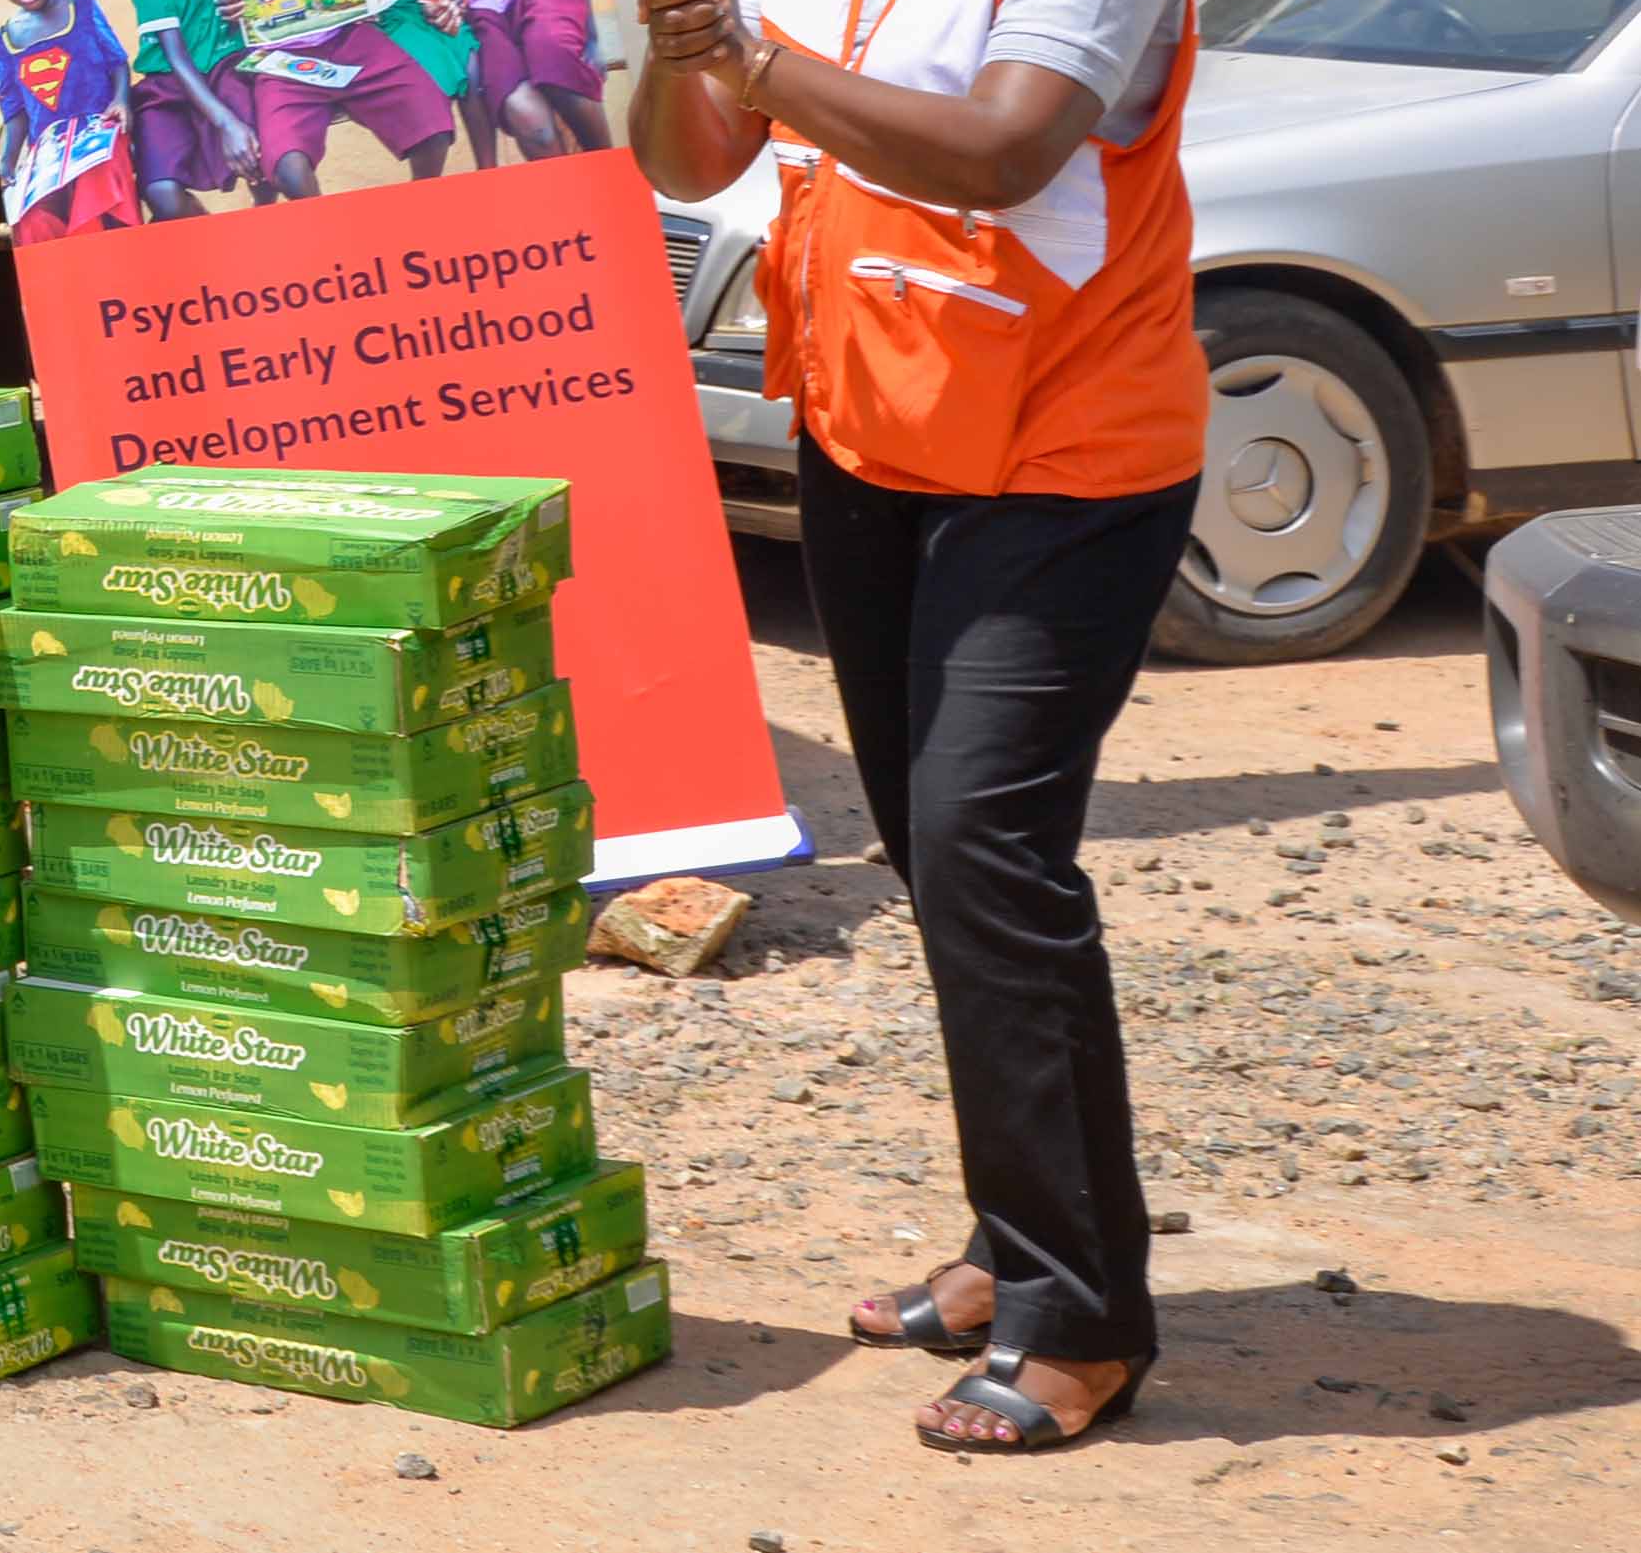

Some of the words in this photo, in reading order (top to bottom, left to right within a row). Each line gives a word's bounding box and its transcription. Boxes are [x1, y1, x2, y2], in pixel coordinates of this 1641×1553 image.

[99, 258, 388, 343] Psychosocial
[402, 231, 596, 293] Support
[125, 355, 207, 403] and
[221, 339, 336, 386] Early
[354, 294, 595, 365] Childhood
[111, 397, 425, 473] Development
[438, 367, 635, 422] Services
[103, 566, 179, 604] Star
[183, 570, 292, 612] White
[73, 666, 143, 705] Star
[147, 668, 251, 714] White
[130, 730, 231, 776] White
[233, 740, 308, 781] Star
[146, 822, 246, 866] White
[248, 835, 321, 877] Star
[135, 914, 233, 958] White
[236, 927, 308, 970] Star
[127, 1012, 227, 1057] White
[229, 1027, 305, 1070] Star
[147, 1117, 247, 1164] White
[249, 1133, 323, 1177] Star
[158, 1240, 230, 1283] Star
[231, 1250, 338, 1300] White
[187, 1326, 258, 1367] Star
[260, 1339, 367, 1387] White
